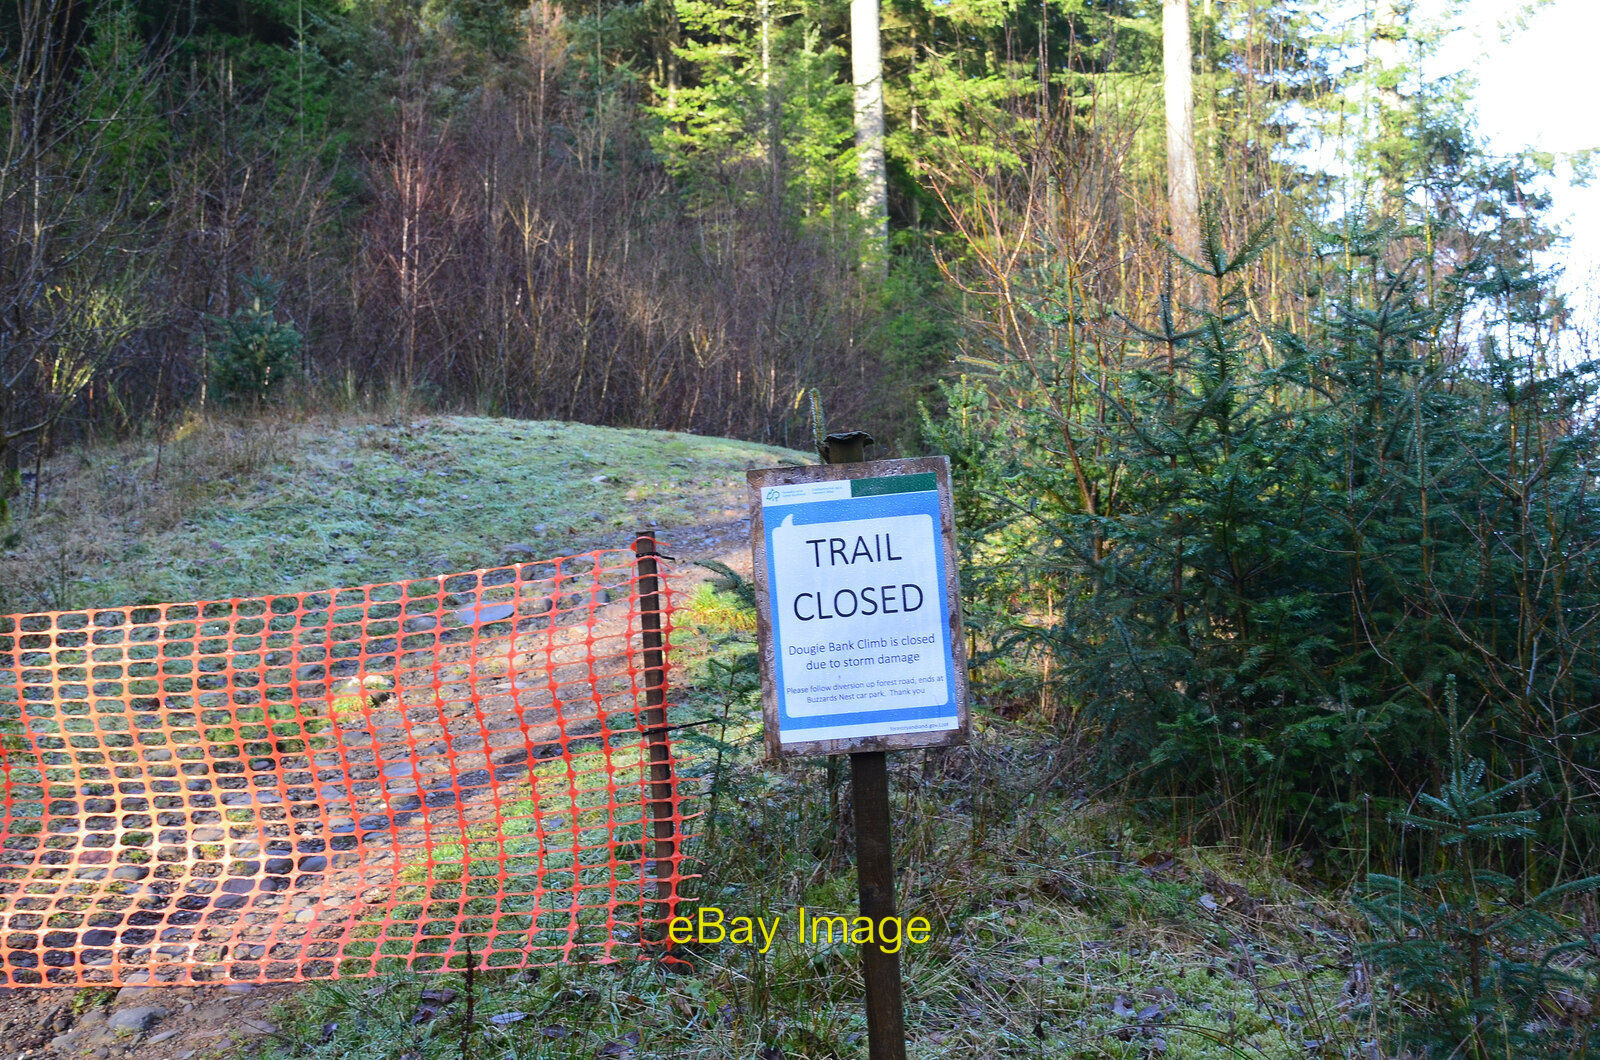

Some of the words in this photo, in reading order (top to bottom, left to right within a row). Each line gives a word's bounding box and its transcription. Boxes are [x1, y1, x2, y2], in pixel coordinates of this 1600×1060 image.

[806, 533, 902, 568] TRAIL
[794, 583, 924, 622] CLOSED
[788, 643, 826, 656] Dougie
[828, 640, 855, 652] Bank
[857, 637, 888, 650] Climb
[890, 637, 899, 647] is
[901, 633, 935, 646] closed
[806, 660, 827, 671] due
[829, 660, 841, 669] to
[843, 656, 875, 668] storm
[877, 653, 920, 665] damage
[786, 687, 809, 695] Please
[810, 685, 831, 693] follow
[832, 682, 864, 692] diversion
[865, 681, 876, 689] up
[876, 679, 898, 687] forest
[918, 675, 935, 684] ends
[936, 675, 945, 683] at
[807, 695, 838, 704] Buzzards
[839, 693, 855, 701] Nest
[856, 692, 868, 700] car
[889, 688, 912, 697] Thank
[912, 687, 926, 696] you
